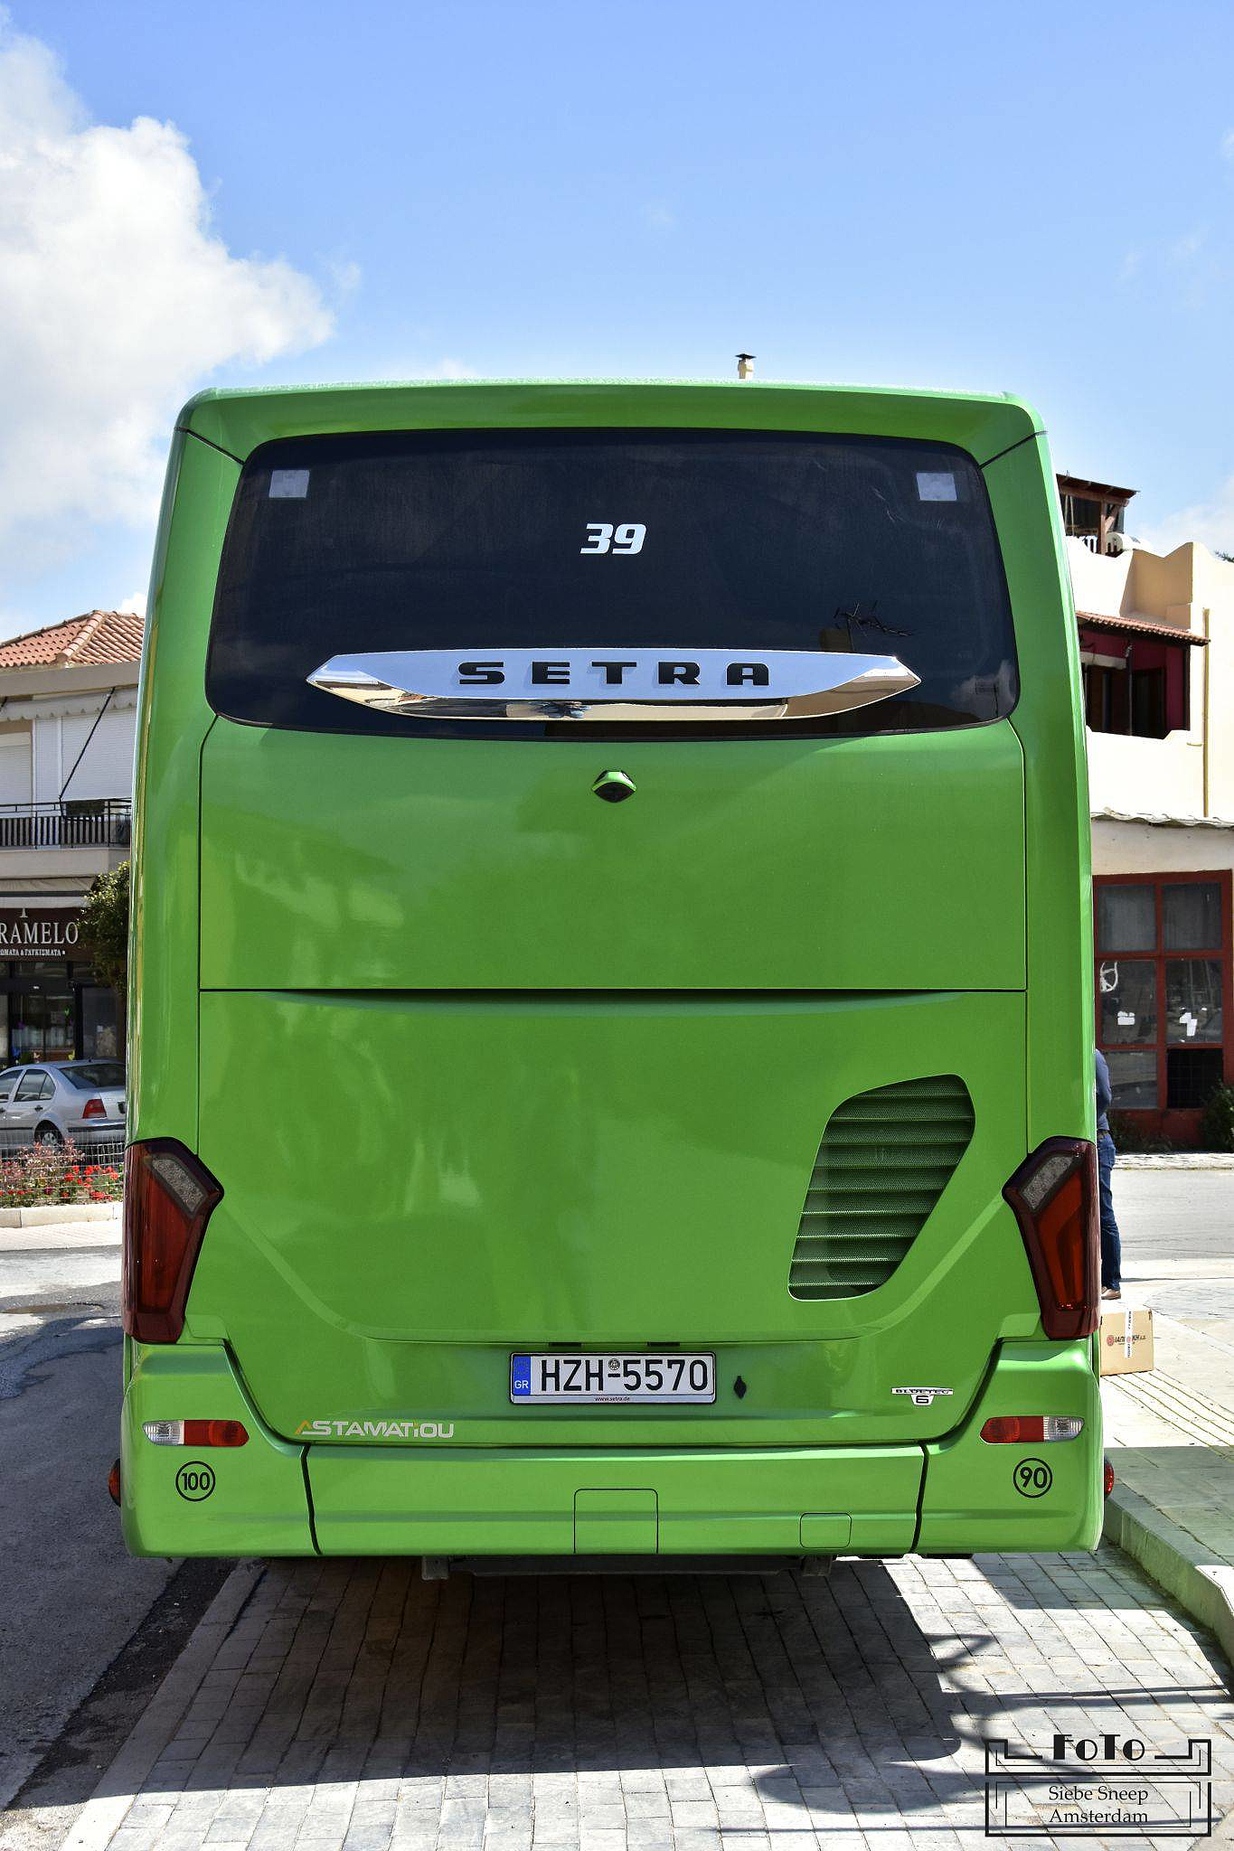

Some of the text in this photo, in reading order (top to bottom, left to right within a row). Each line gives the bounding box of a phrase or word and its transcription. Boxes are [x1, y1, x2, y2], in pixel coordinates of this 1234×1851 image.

[580, 523, 647, 555] 39
[457, 661, 770, 686] SETRA
[514, 1380, 529, 1389] GR
[541, 1359, 708, 1391] HZH-5570
[916, 1395, 930, 1404] 6
[181, 1471, 210, 1491] 100
[1020, 1467, 1048, 1488] 90
